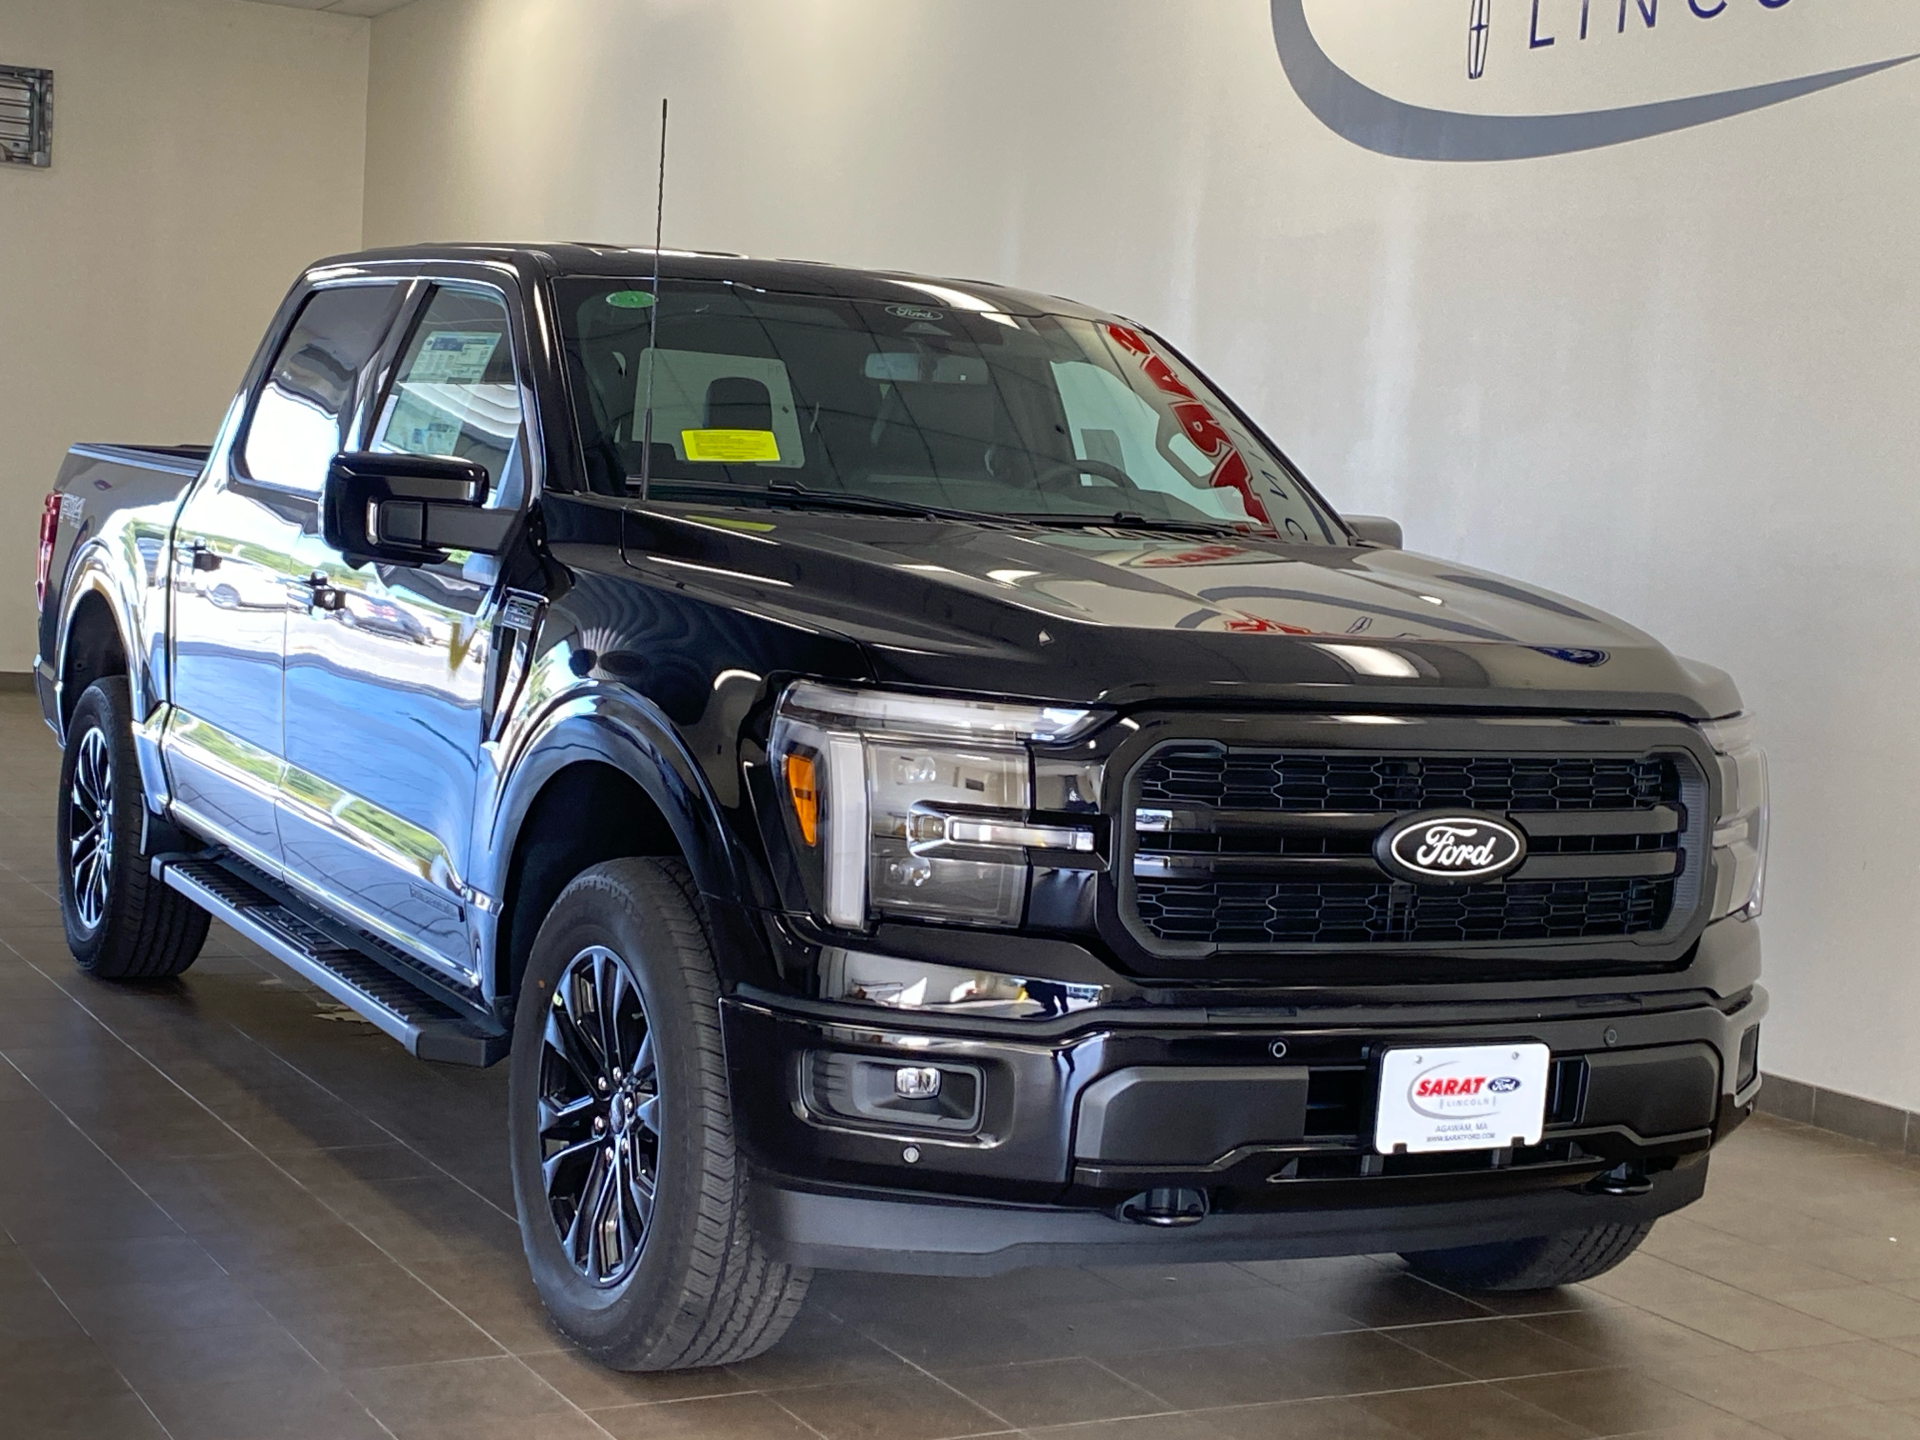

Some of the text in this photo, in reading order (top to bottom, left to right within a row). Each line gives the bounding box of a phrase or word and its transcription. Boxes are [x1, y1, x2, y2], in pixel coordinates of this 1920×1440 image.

[1416, 826, 1496, 866] Ford
[1416, 1076, 1487, 1097] SARAT
[1446, 1098, 1490, 1107] LINCOLN
